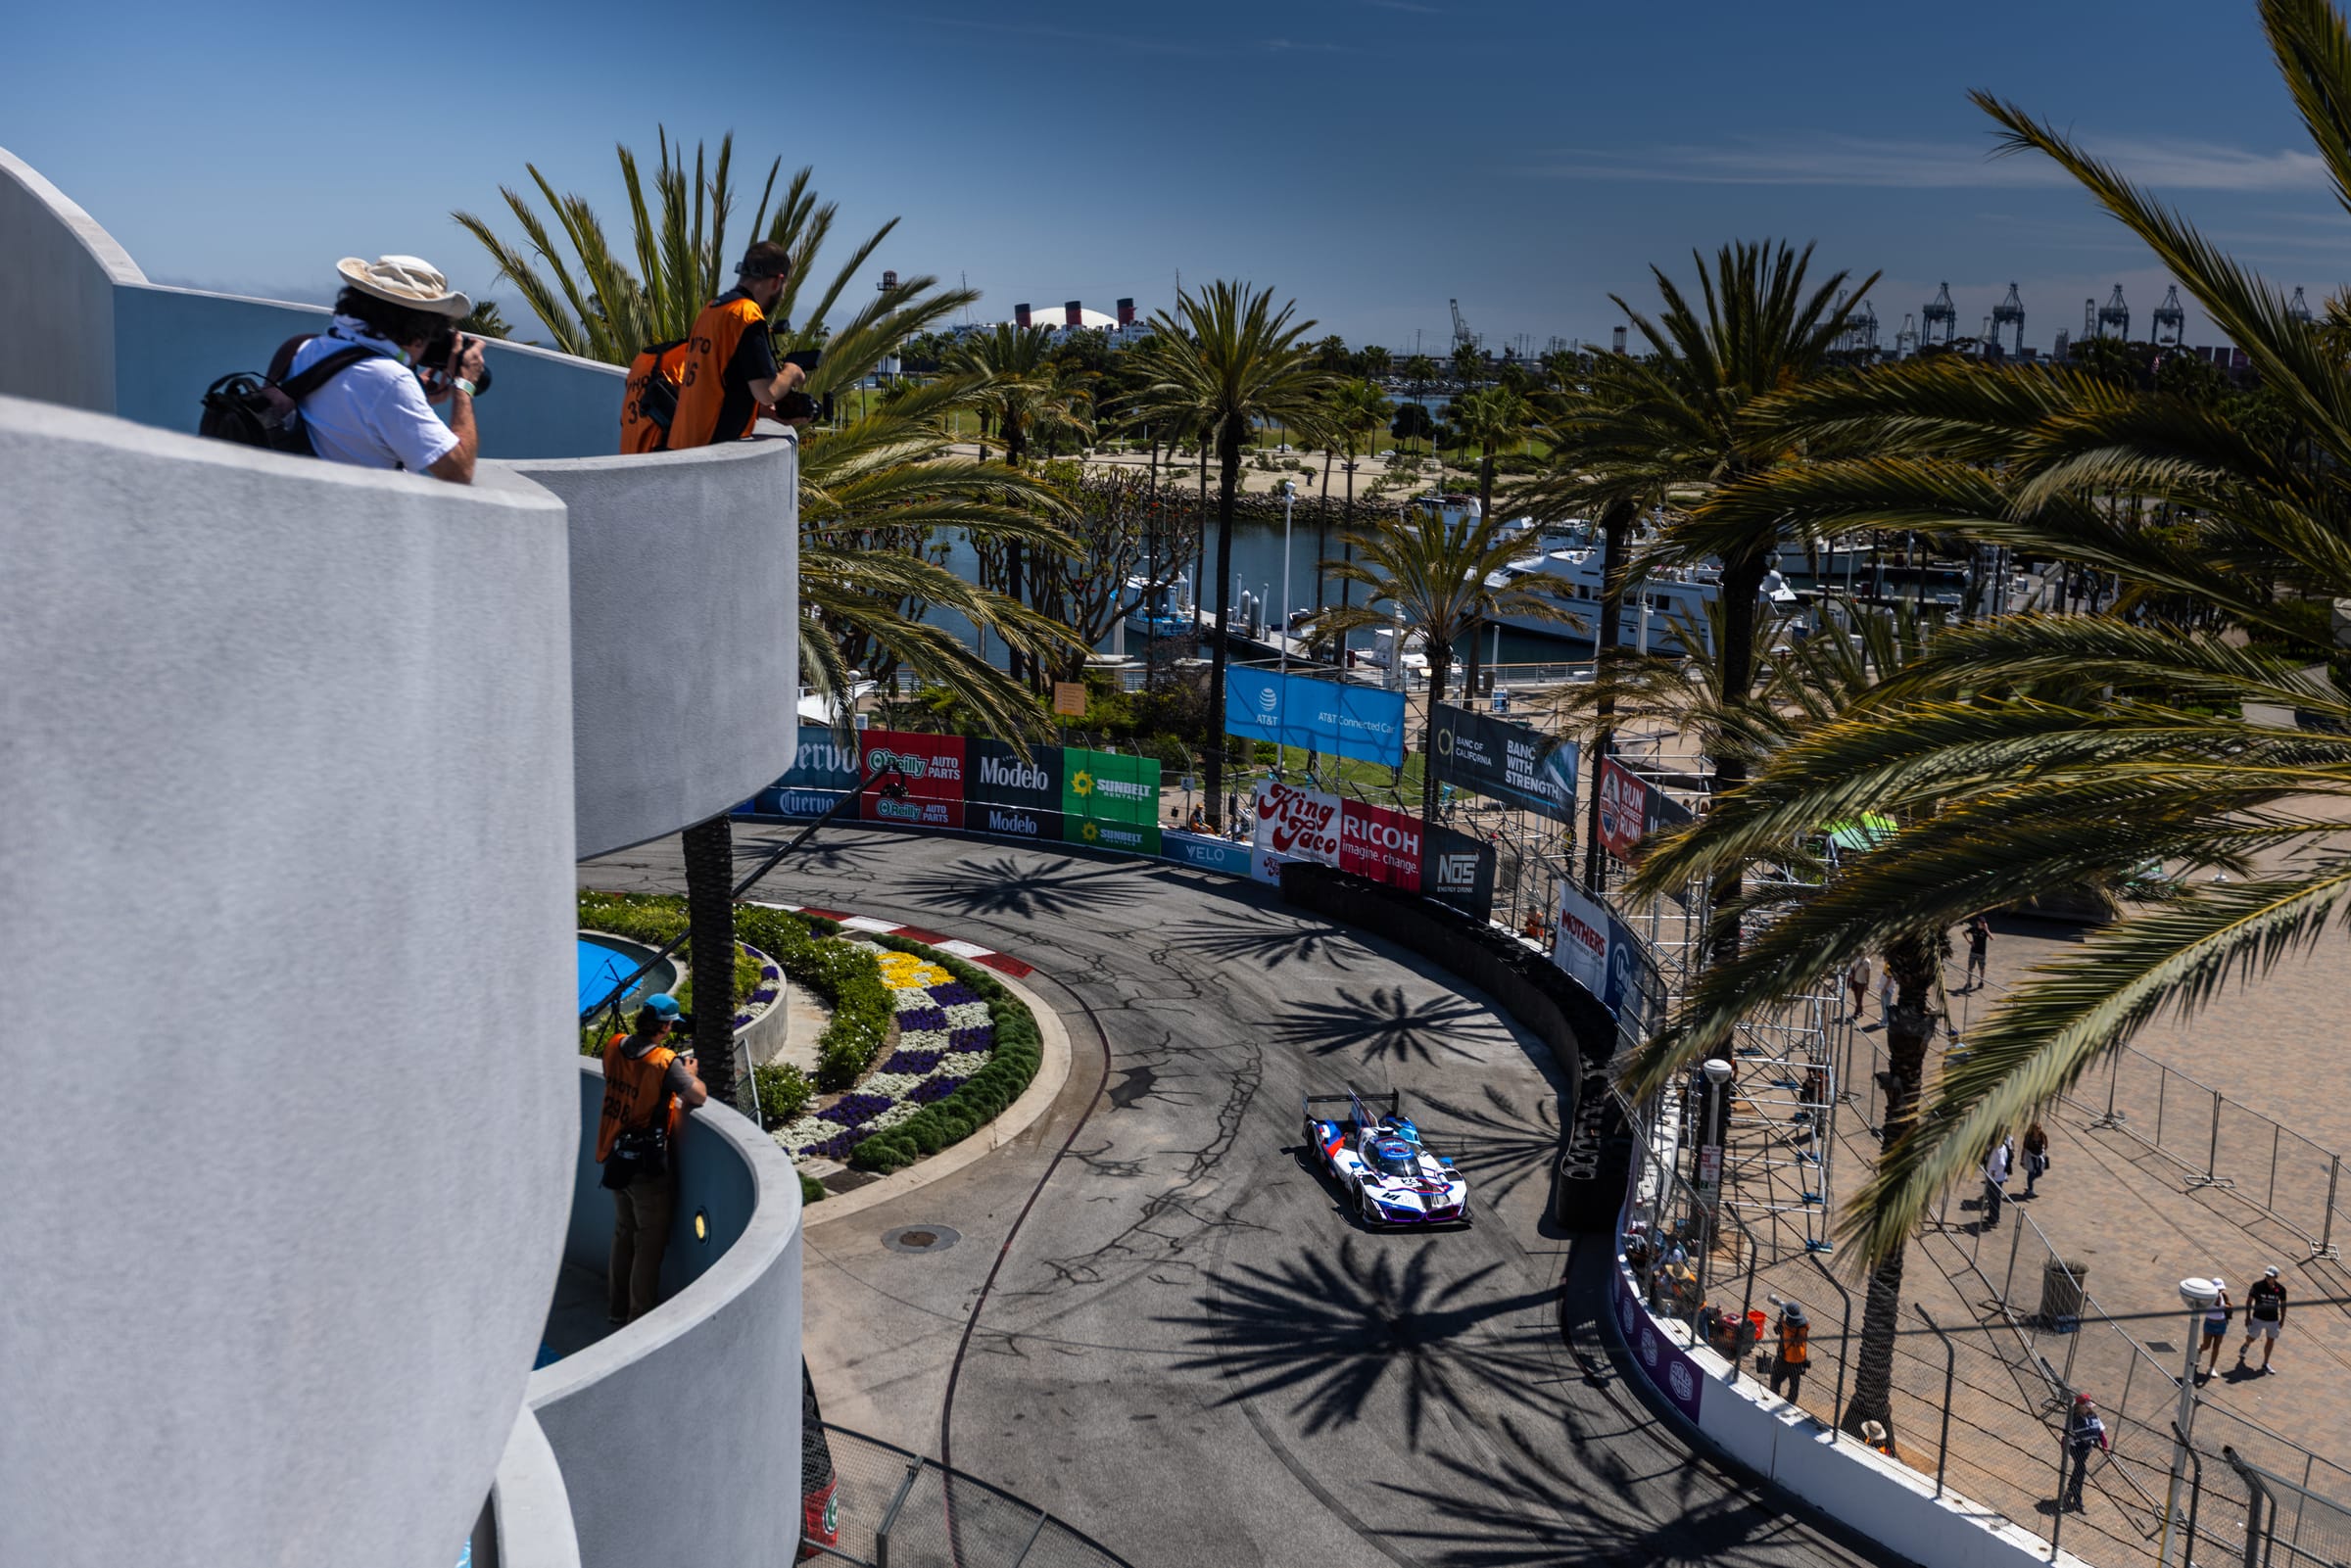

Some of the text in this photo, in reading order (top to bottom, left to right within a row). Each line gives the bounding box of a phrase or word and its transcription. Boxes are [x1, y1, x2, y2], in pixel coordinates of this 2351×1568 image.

[1256, 714, 1278, 727] AT&T
[1319, 712, 1336, 724] AT&T
[1338, 715, 1380, 732] Connected
[1456, 736, 1484, 751] BANC OF
[1508, 739, 1536, 761] BANC
[796, 742, 857, 775] ervo
[931, 756, 959, 769] AUTO
[1456, 748, 1492, 767] CALIFORNIA
[1507, 755, 1533, 776] WITH
[928, 768, 961, 781] PARTS
[980, 756, 1049, 790] Modelo
[1096, 779, 1151, 797] SUNBELT
[1506, 770, 1559, 799] STRENGTH
[1103, 791, 1142, 801] RENTALS
[1622, 781, 1643, 812] RUN
[877, 798, 924, 821] O'Reilly
[923, 813, 948, 823] PARTS
[926, 804, 947, 814] AUTO
[1258, 784, 1335, 832] King
[989, 811, 1037, 834] Modelo
[1100, 828, 1143, 842] SUNBELT
[1272, 815, 1338, 854] Taco
[1343, 814, 1419, 856] RICOH
[1186, 845, 1224, 862] VELO
[1342, 839, 1380, 862] imagine.
[1383, 853, 1418, 874] change.
[1438, 853, 1479, 884] NOS
[1561, 909, 1607, 958] MOTHERS
